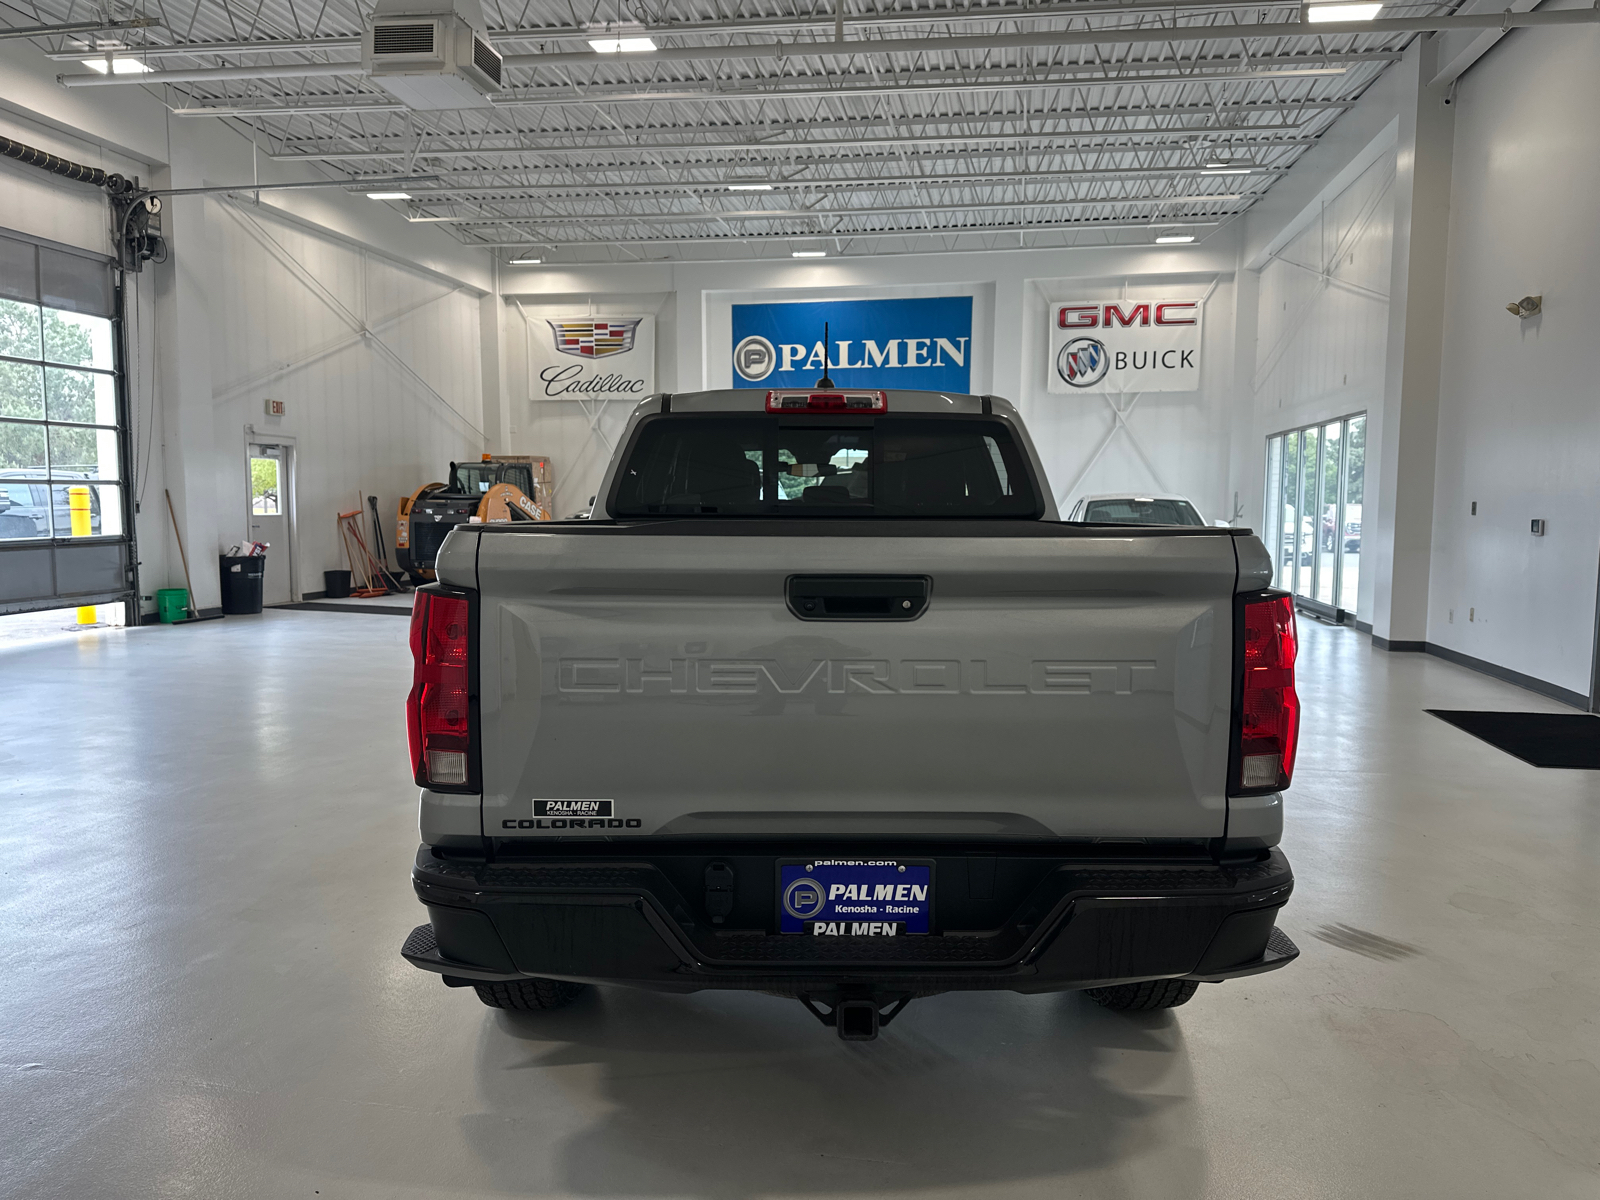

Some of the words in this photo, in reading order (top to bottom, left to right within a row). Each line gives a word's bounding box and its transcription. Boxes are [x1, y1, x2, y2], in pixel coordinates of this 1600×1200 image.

[1058, 302, 1198, 330] GMC
[778, 337, 969, 371] PALMEN
[1115, 349, 1195, 370] BUICK
[540, 364, 644, 396] Cadillac
[272, 401, 283, 414] EXIT
[520, 496, 542, 520] CASE
[558, 657, 1157, 693] CHEVROLET
[546, 801, 600, 811] PALMEN
[502, 819, 642, 829] COLORADO
[814, 859, 897, 867] palmen.com
[828, 884, 928, 901] PALMEN
[835, 905, 877, 914] Kenosha
[885, 905, 920, 914] Racine
[813, 922, 897, 937] PALMEN
